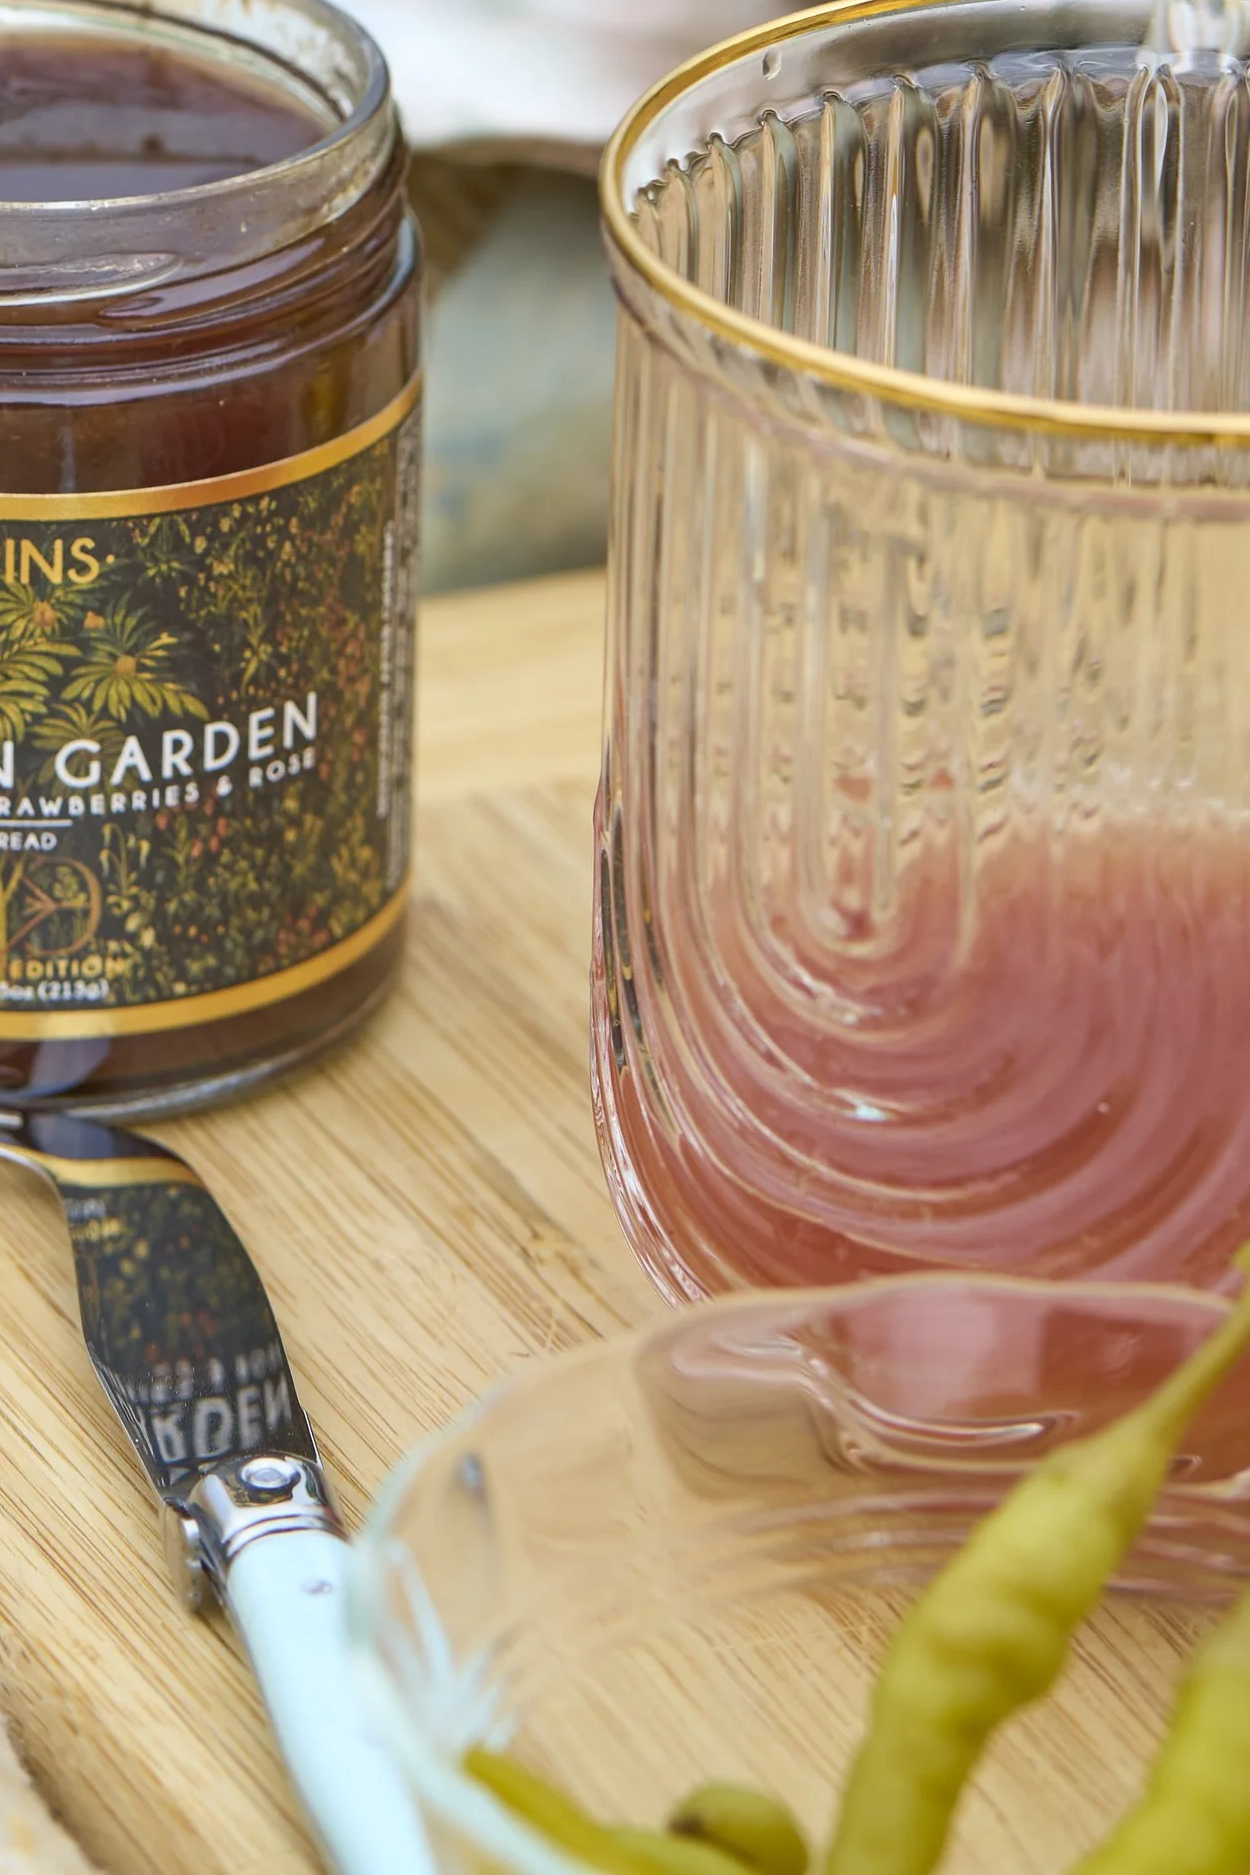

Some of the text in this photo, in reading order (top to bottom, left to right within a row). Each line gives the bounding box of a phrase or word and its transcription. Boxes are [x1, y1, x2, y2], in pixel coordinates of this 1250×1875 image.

[54, 691, 318, 789] GARDEN
[216, 776, 233, 797] &
[248, 747, 318, 789] ROSE
[8, 954, 126, 981] EDITION
